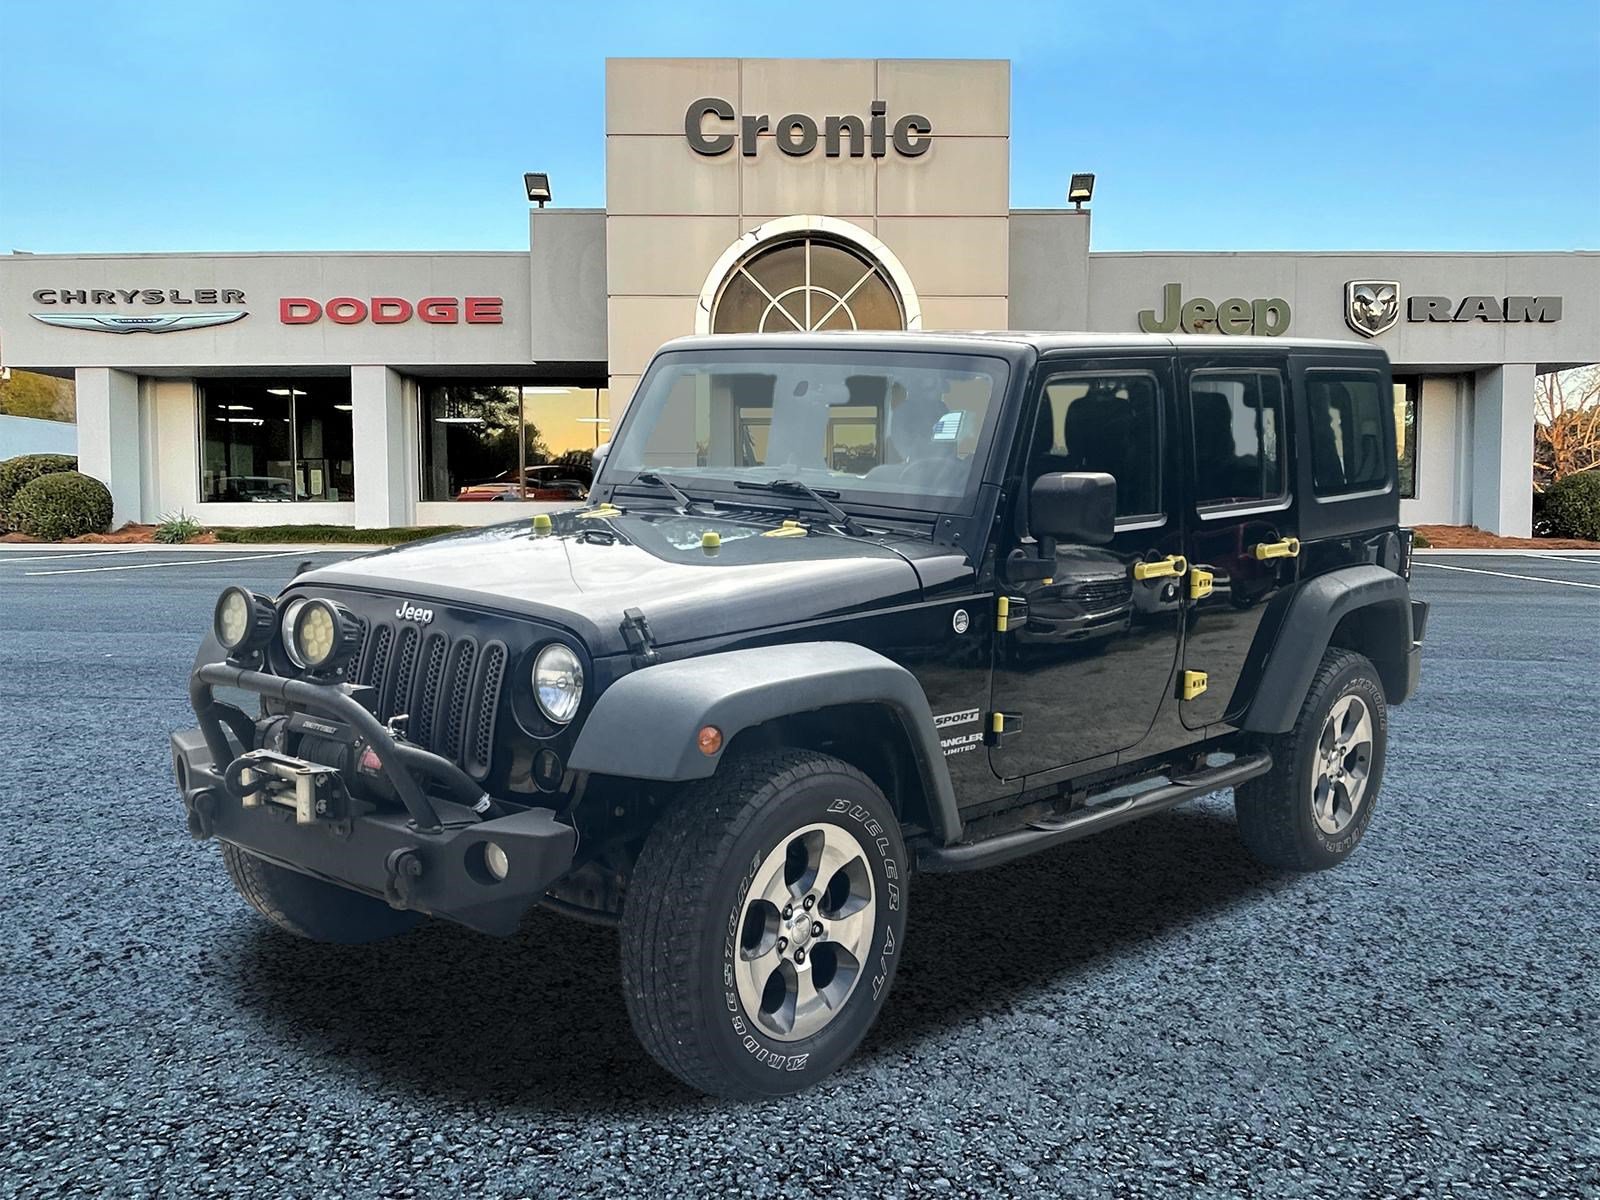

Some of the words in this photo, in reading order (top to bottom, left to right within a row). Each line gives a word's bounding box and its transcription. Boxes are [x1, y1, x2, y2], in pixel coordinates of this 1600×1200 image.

[684, 97, 932, 157] Cronic
[32, 289, 246, 305] CHRYSLER
[279, 297, 503, 324] DODGE
[1138, 283, 1291, 337] Jeep
[1407, 296, 1563, 323] RAM
[395, 601, 433, 624] Jeep
[935, 711, 977, 726] SPORT
[940, 733, 983, 748] ANGLER
[943, 744, 976, 756] LIMITED
[827, 799, 899, 911] DUELER
[723, 849, 810, 1072] BRIDGESTONE
